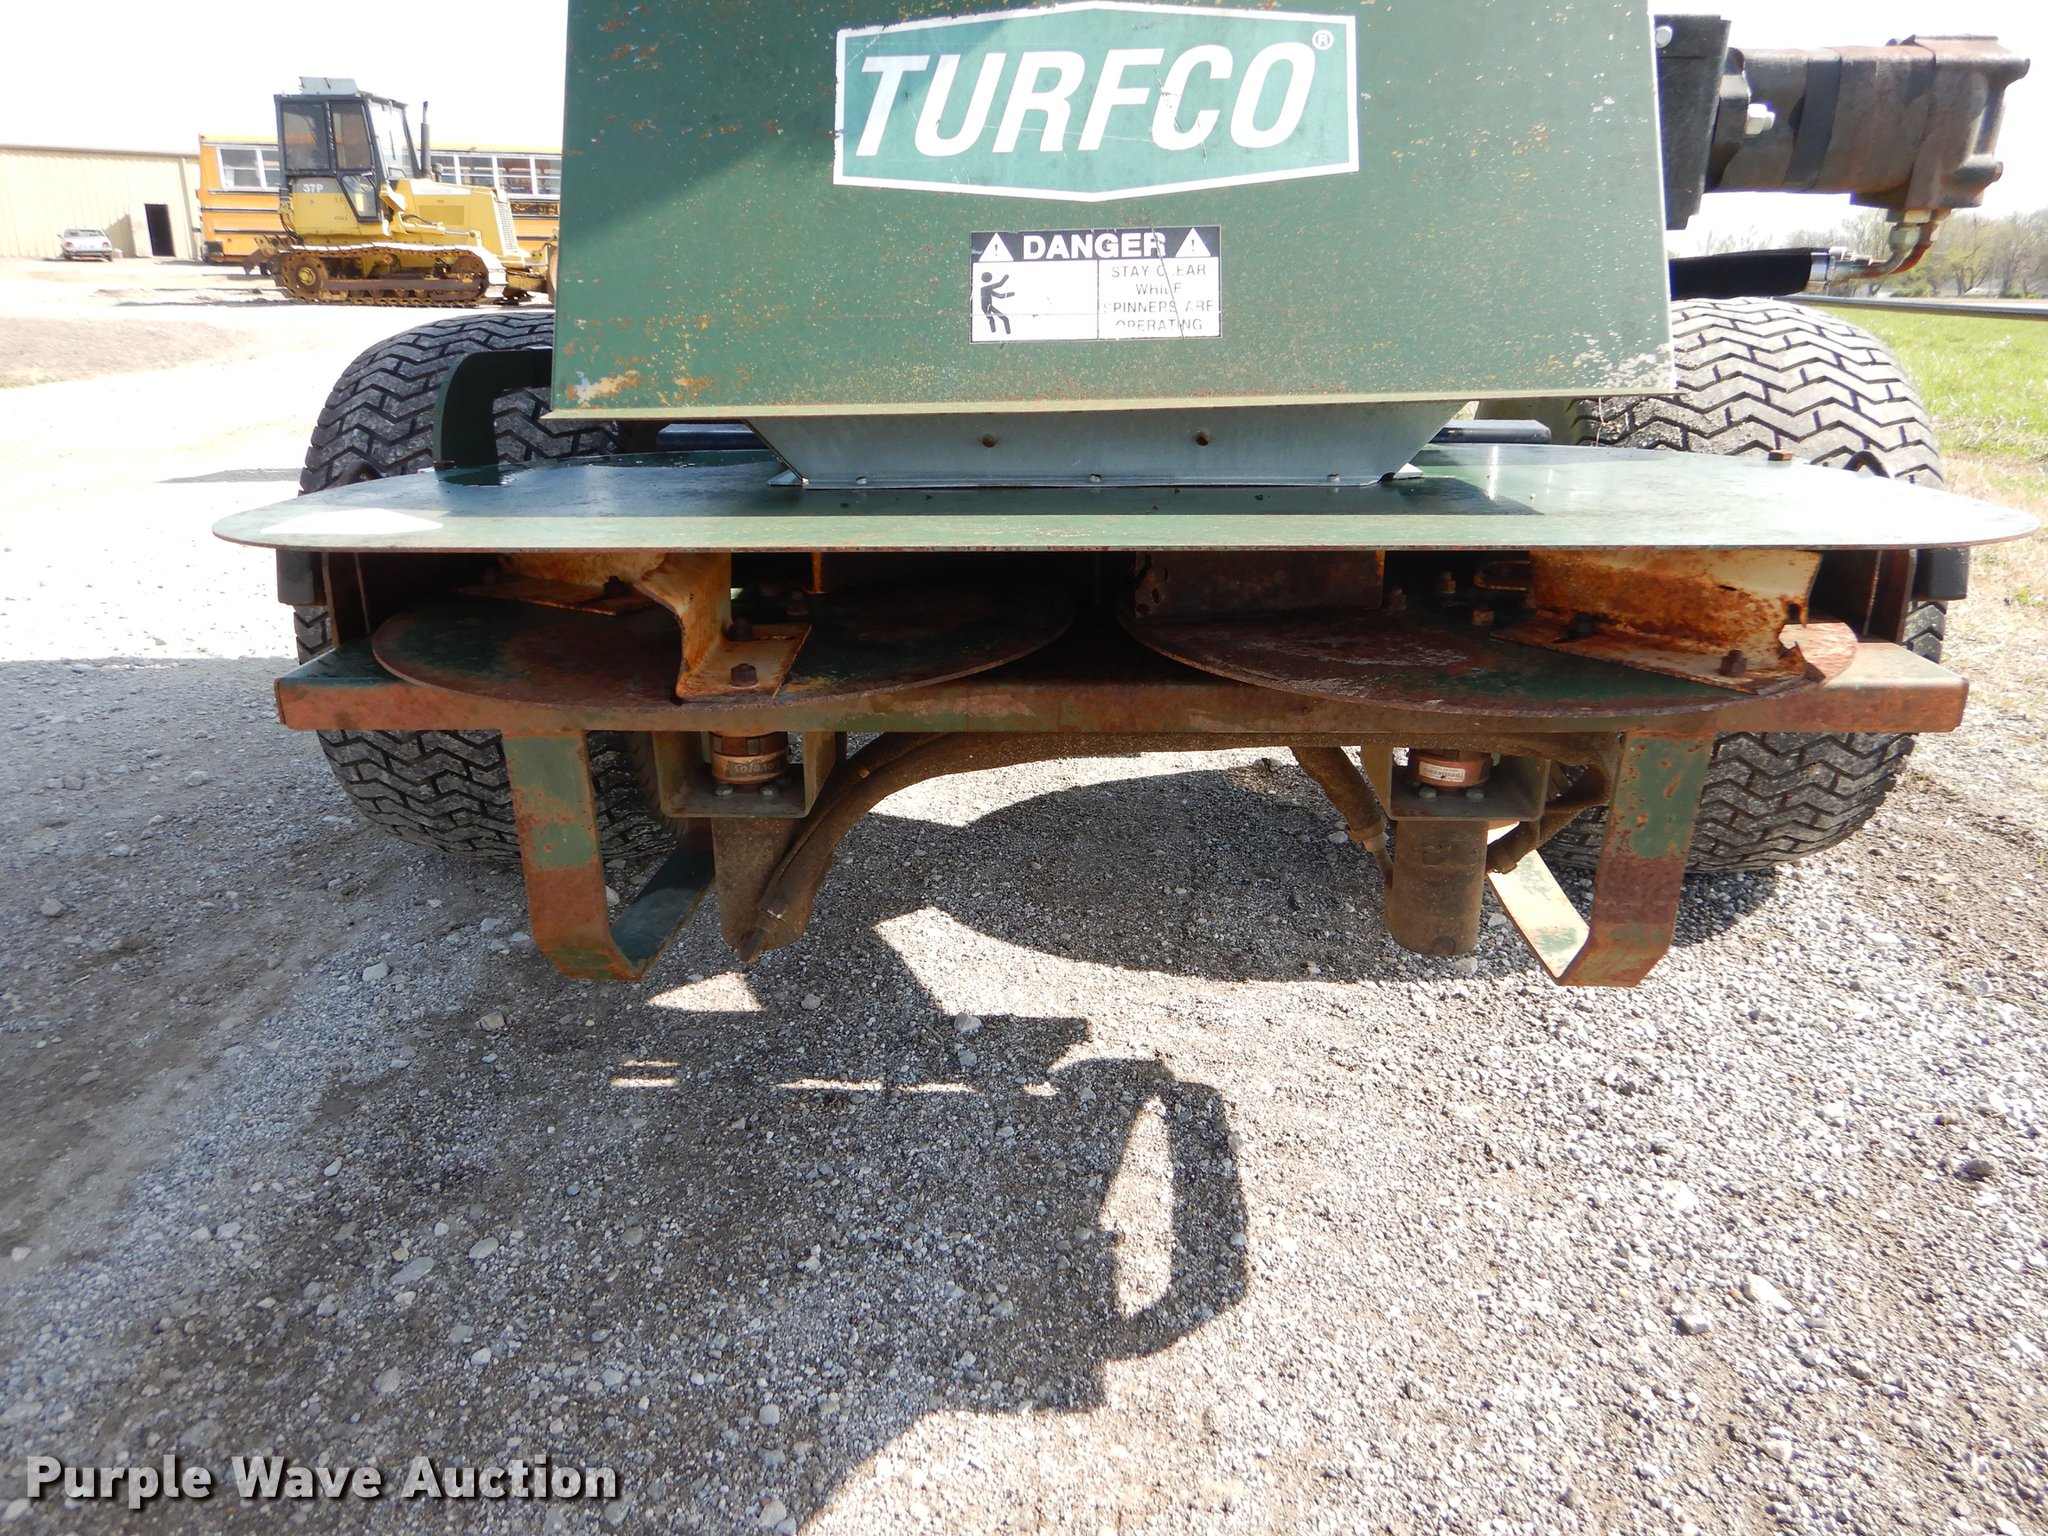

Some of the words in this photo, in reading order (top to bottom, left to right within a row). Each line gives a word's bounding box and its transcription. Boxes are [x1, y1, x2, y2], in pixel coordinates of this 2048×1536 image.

[855, 41, 1316, 157] TURFCO
[1023, 232, 1166, 260] DANGER
[1111, 265, 1149, 278] STAY
